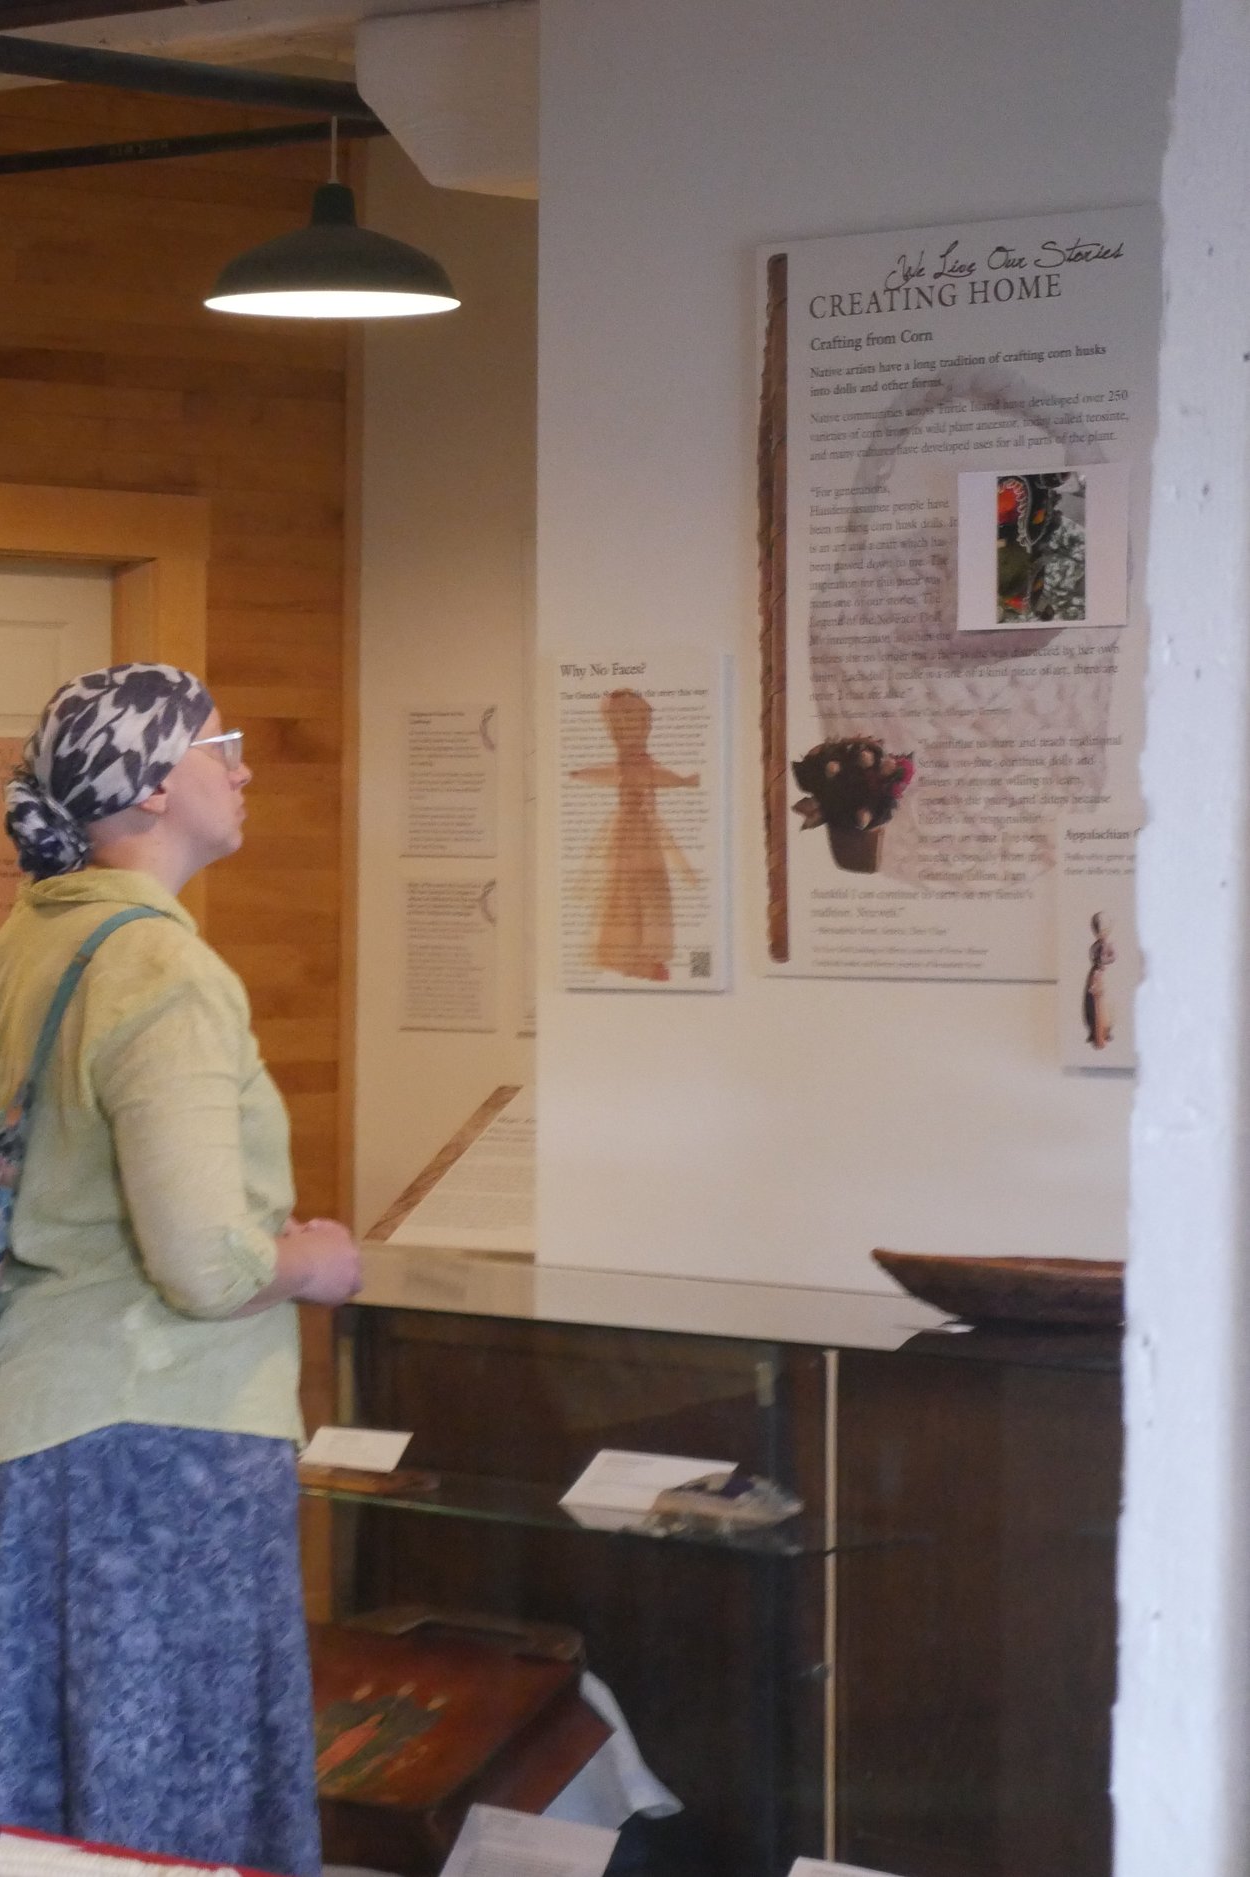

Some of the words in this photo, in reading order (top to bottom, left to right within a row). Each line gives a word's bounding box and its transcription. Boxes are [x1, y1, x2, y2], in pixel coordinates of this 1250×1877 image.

[933, 240, 976, 279] Live
[987, 246, 1027, 270] Our
[1034, 237, 1125, 268] Stories
[809, 283, 957, 320] CREATING
[968, 273, 1063, 306] HOME
[810, 335, 862, 351] Crafting
[866, 332, 897, 347] from
[900, 329, 934, 343] Corn
[810, 367, 842, 379] Native
[845, 364, 875, 376] artists
[879, 362, 902, 373] have
[913, 359, 936, 372] long
[939, 354, 986, 368] tradition
[989, 352, 1001, 363] of
[1002, 350, 1045, 363] crafting
[1047, 348, 1072, 359] corn
[1075, 344, 1107, 357] husks
[810, 386, 831, 397] into
[833, 383, 857, 395] dolls
[860, 381, 879, 392] and
[881, 380, 909, 391] other
[810, 413, 840, 424] Native
[842, 409, 902, 422] communities
[1028, 394, 1080, 409] developed
[862, 428, 883, 438] corn
[1053, 414, 1082, 425] called
[810, 450, 827, 461] and
[921, 441, 969, 454] developed
[996, 437, 1010, 447] for
[1013, 435, 1025, 446] all
[1069, 431, 1085, 442] the
[892, 500, 924, 514] people
[927, 499, 949, 510] have
[810, 525, 831, 535] been
[871, 522, 892, 532] corn
[895, 519, 917, 530] husk
[810, 563, 831, 573] been
[560, 664, 587, 680] Why
[590, 663, 608, 677] No
